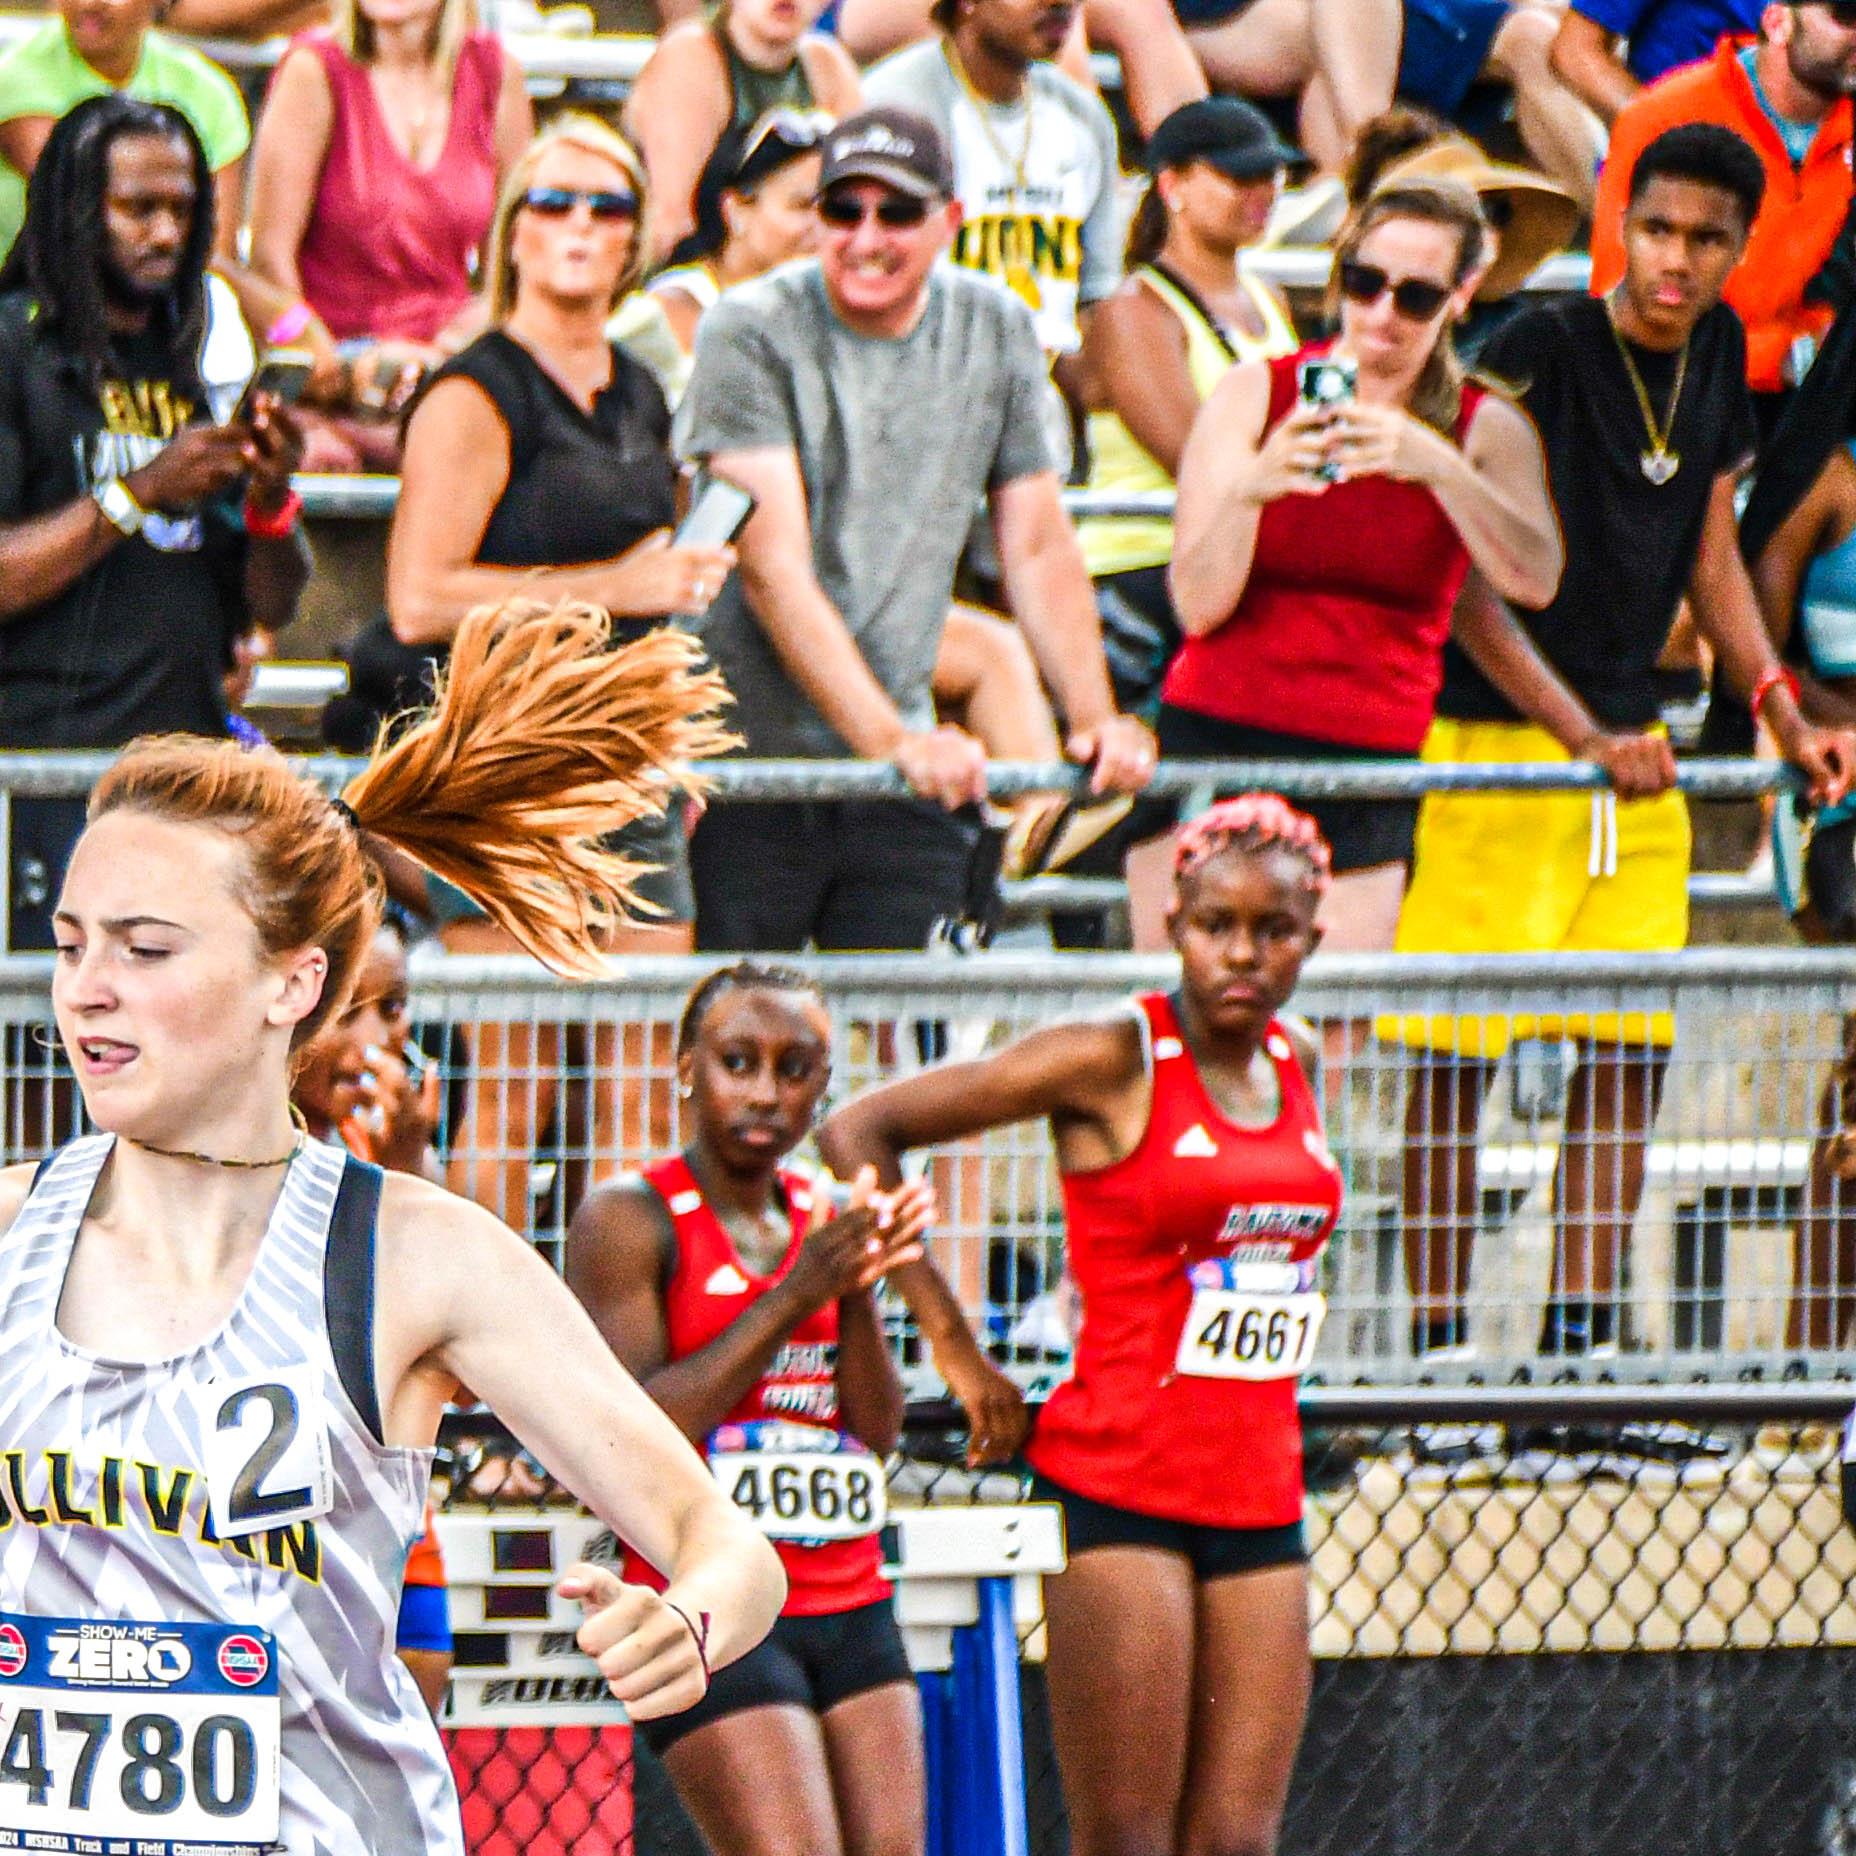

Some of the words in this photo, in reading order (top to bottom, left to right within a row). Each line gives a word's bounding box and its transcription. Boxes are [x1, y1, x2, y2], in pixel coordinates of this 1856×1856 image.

[1196, 1306, 1312, 1366] 4661
[216, 1382, 314, 1524] 2
[731, 1461, 874, 1524] 4668
[79, 1624, 157, 1640] SHOW-ME
[47, 1636, 192, 1682] ZERO
[74, 1837, 102, 1855] Track
[108, 1840, 130, 1856] and
